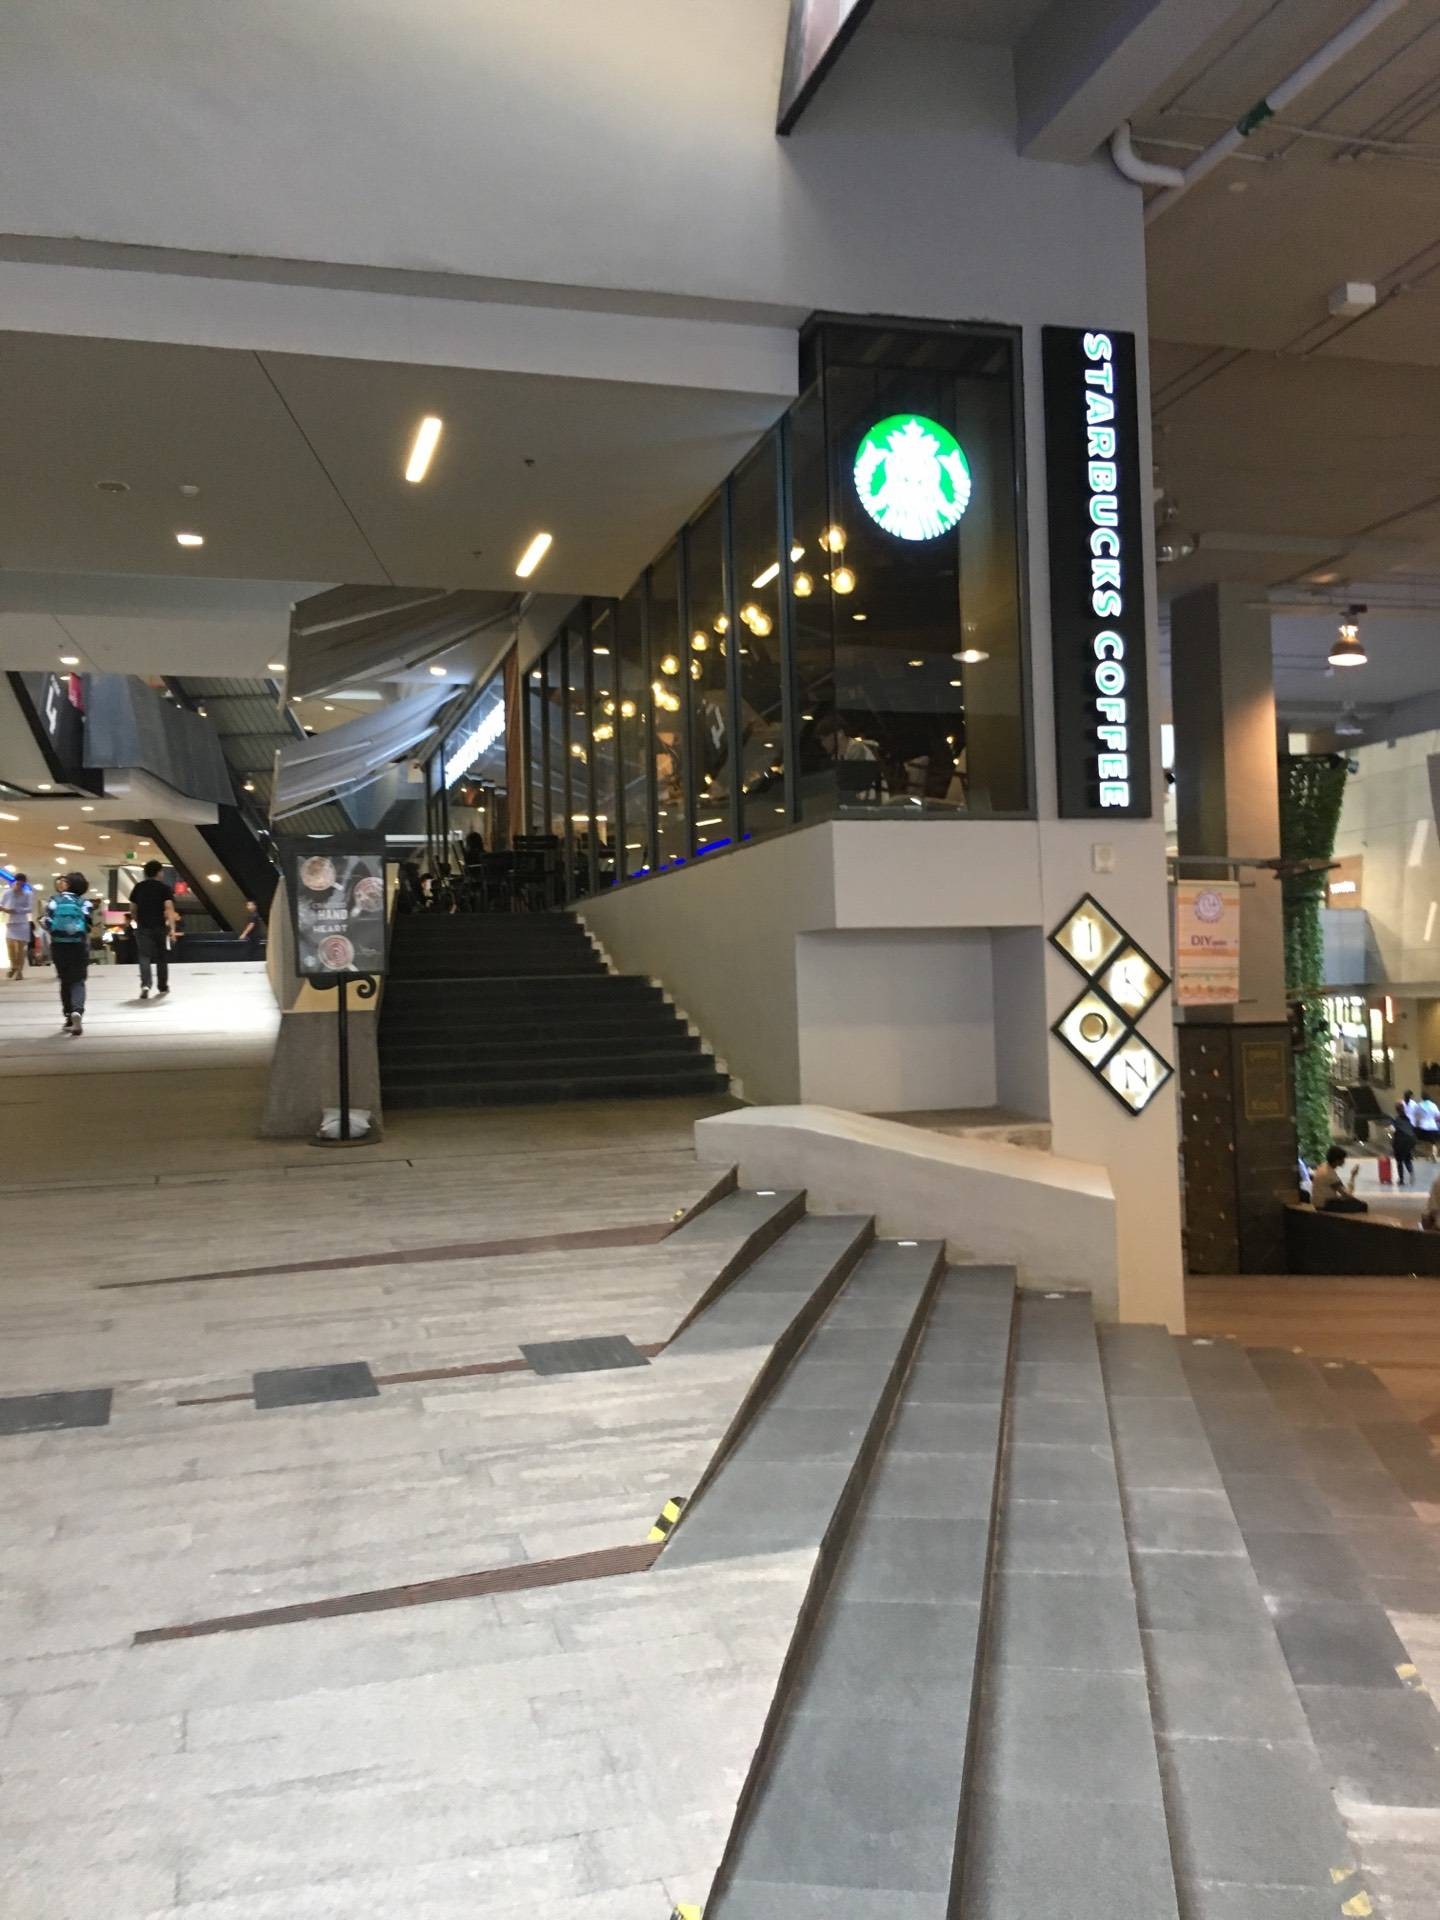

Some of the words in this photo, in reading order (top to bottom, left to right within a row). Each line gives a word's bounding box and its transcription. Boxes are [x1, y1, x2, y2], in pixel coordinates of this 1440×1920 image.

[1083, 331, 1122, 618] STARBUCKS
[1093, 630, 1130, 809] COFFEE
[1191, 935, 1212, 946] DIY
